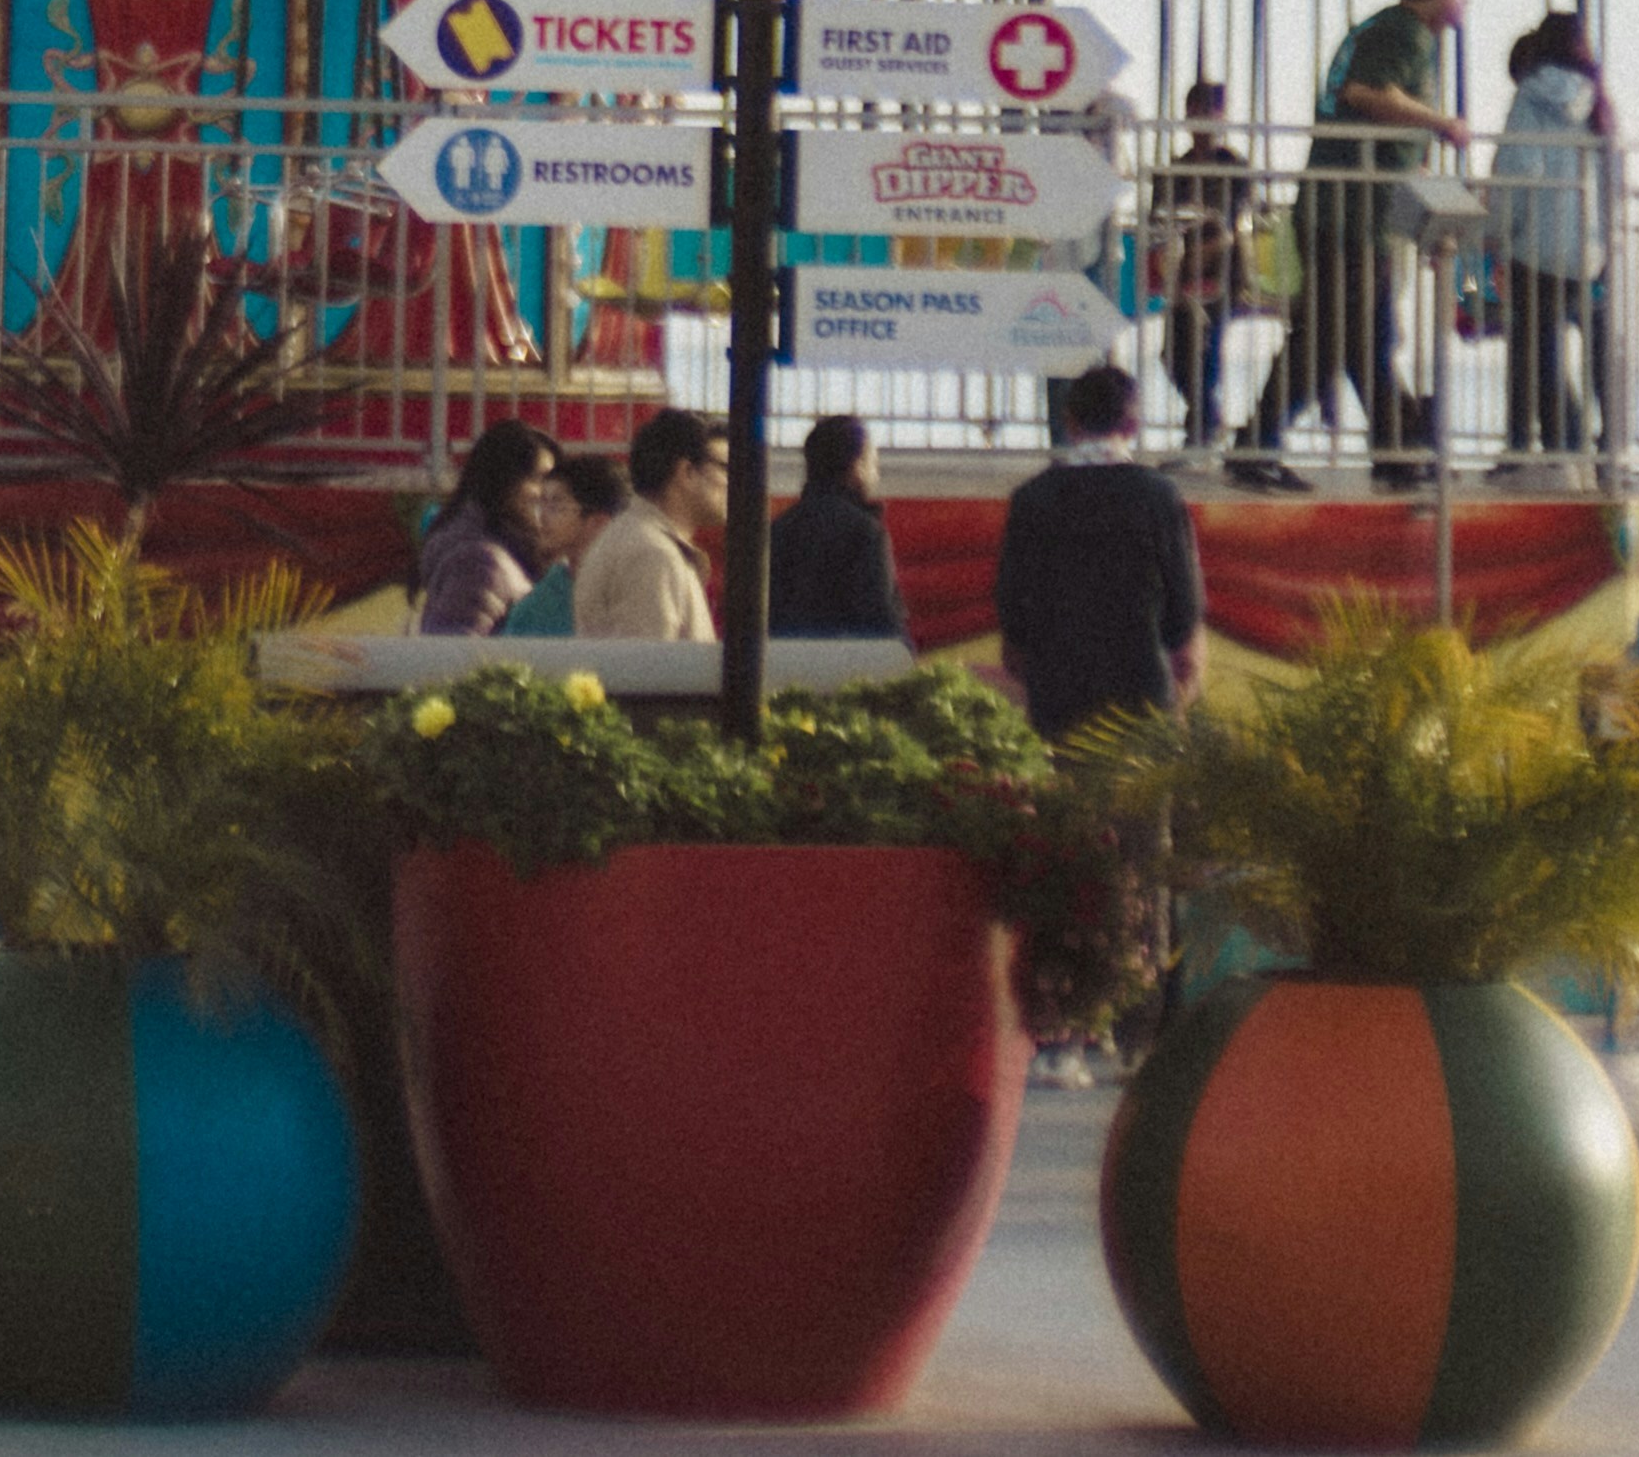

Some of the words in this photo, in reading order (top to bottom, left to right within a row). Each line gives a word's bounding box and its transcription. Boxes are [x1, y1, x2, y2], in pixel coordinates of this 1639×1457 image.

[532, 16, 695, 55] TICKETS
[823, 29, 894, 53] FIRST
[903, 32, 951, 56] AID
[820, 57, 871, 70] GUEST
[877, 59, 949, 73] SERVICES
[903, 142, 1004, 170] GIANT
[533, 160, 695, 187] RESTROOMS
[871, 165, 1037, 205] DIPPER
[893, 206, 1004, 223] ENTRANCE
[814, 290, 915, 312] SEASON
[921, 292, 982, 315] PASS
[814, 317, 898, 340] OFFICE
